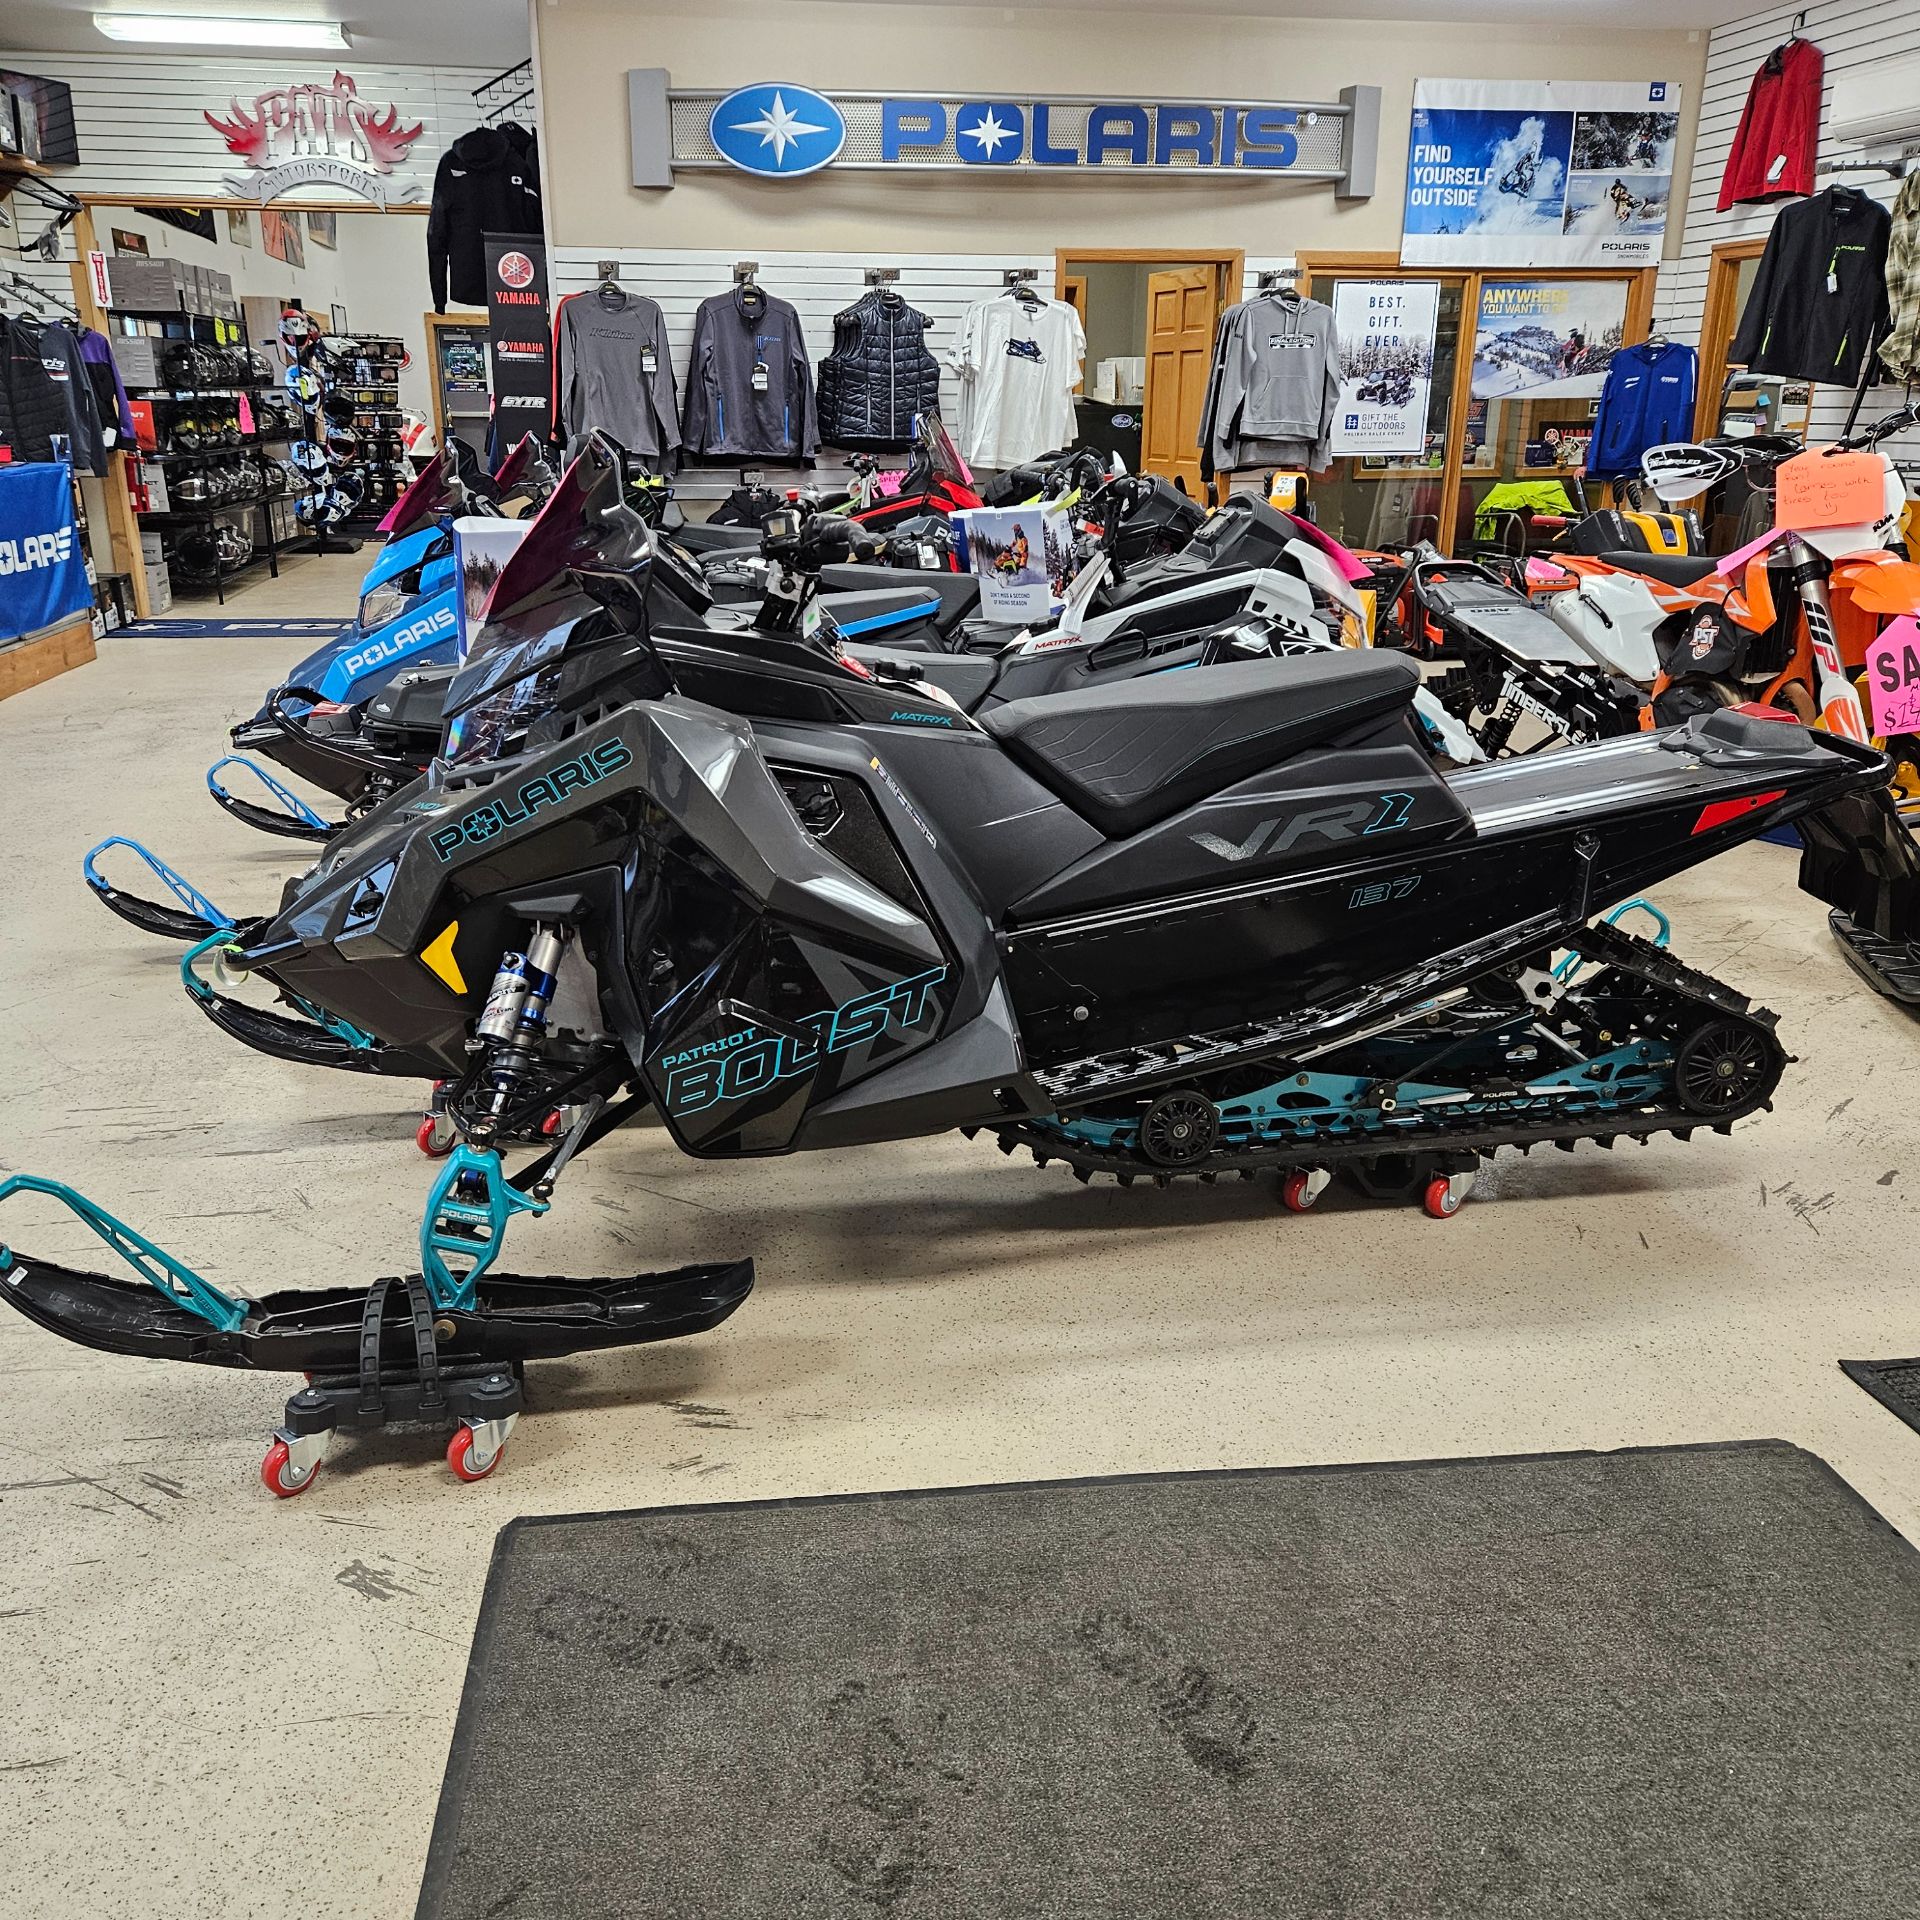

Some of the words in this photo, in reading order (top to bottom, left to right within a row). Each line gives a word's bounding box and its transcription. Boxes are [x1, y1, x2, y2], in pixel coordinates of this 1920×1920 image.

[882, 101, 1299, 167] POLARIS
[1414, 144, 1452, 164] FIND
[263, 162, 383, 199] MOTORSPORTS
[1414, 166, 1494, 185] YOURSELF
[1411, 188, 1478, 206] OUTSIDE
[1601, 242, 1650, 251] POLARIS
[495, 291, 541, 305] YAMAHA
[1369, 296, 1406, 309] BEST.
[1482, 303, 1503, 314] YOU
[1505, 303, 1535, 314] WANT
[1536, 303, 1550, 313] TO
[1369, 316, 1403, 328] GIFT.
[507, 341, 545, 353] YAMAHA
[1365, 335, 1403, 348] EVER.
[500, 396, 548, 409] GYTR
[1361, 413, 1380, 422] GIFT
[1383, 413, 1399, 421] THE
[1361, 421, 1406, 430] OUTDOORS
[1845, 477, 1872, 487] with
[1873, 513, 1895, 533] KTM
[344, 606, 456, 675] POLARIS
[1034, 635, 1083, 651] MATRYX
[890, 711, 953, 727] MATRYX
[428, 736, 633, 863] POLARIS
[1186, 792, 1416, 862] VR1
[1348, 875, 1423, 910] 137
[661, 1026, 757, 1070] PATRIOT
[666, 966, 947, 1118] BOOST
[1482, 1091, 1519, 1099] POLARIS
[440, 1207, 490, 1224] POLARIS
